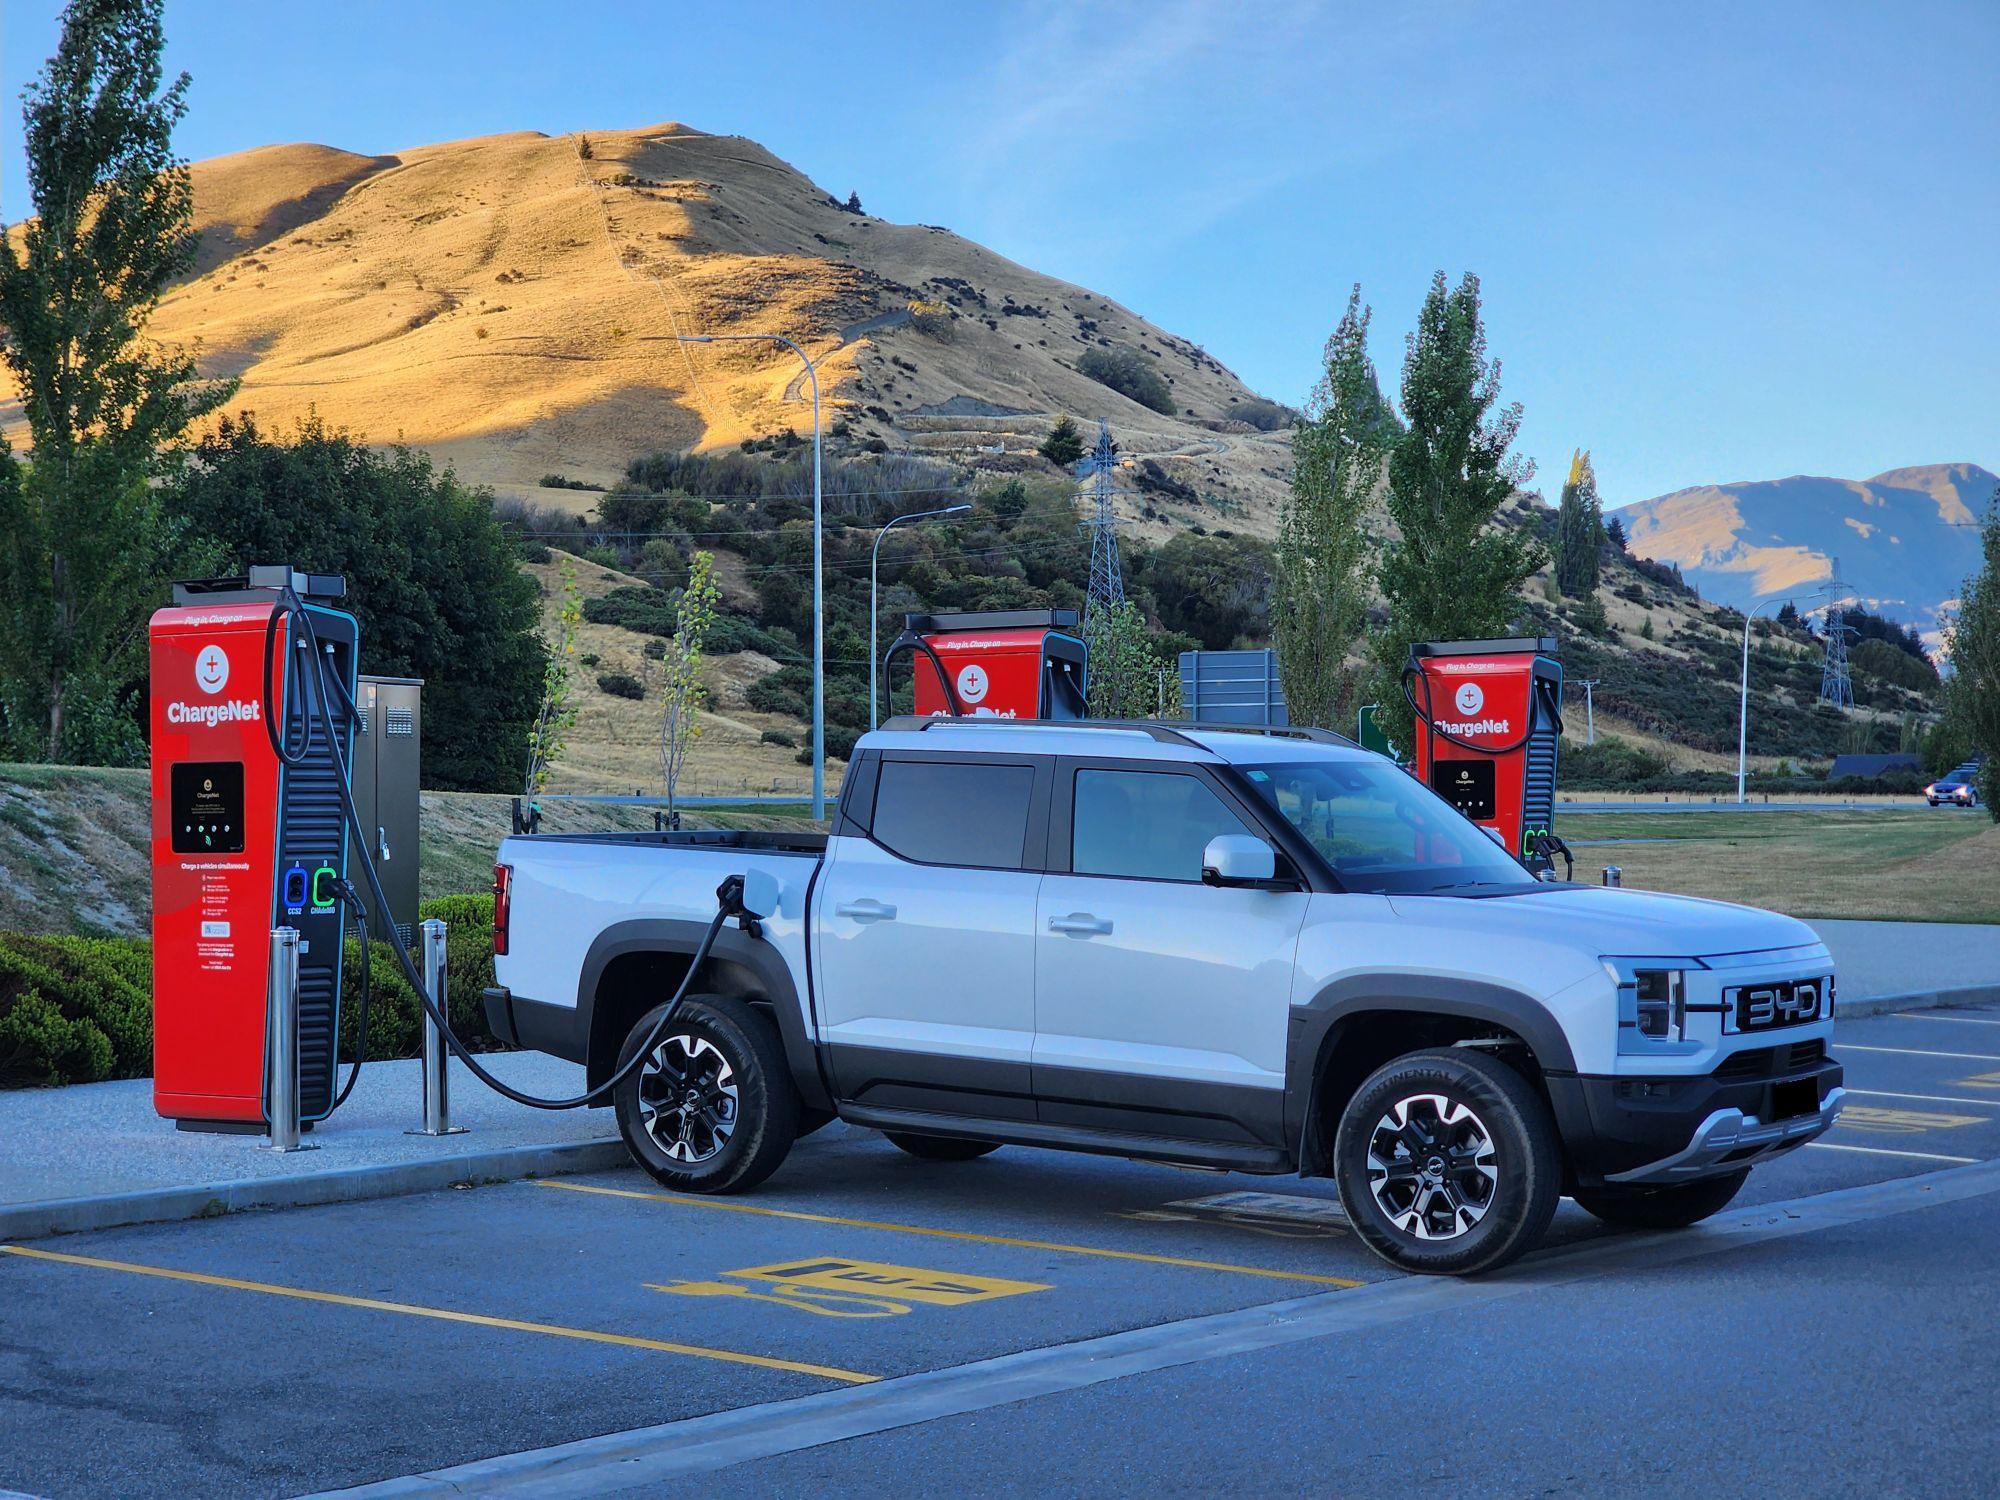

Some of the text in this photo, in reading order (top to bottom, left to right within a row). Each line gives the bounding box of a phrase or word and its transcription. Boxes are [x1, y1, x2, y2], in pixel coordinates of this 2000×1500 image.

[209, 615, 233, 625] Charge
[946, 641, 961, 650] Plug
[969, 640, 991, 649] Charge
[167, 700, 260, 727] ChargeNet
[295, 860, 300, 868] A
[288, 907, 302, 915] CCS2
[1750, 984, 1818, 1025] BYD
[1358, 1068, 1453, 1112] CONTINENTAL
